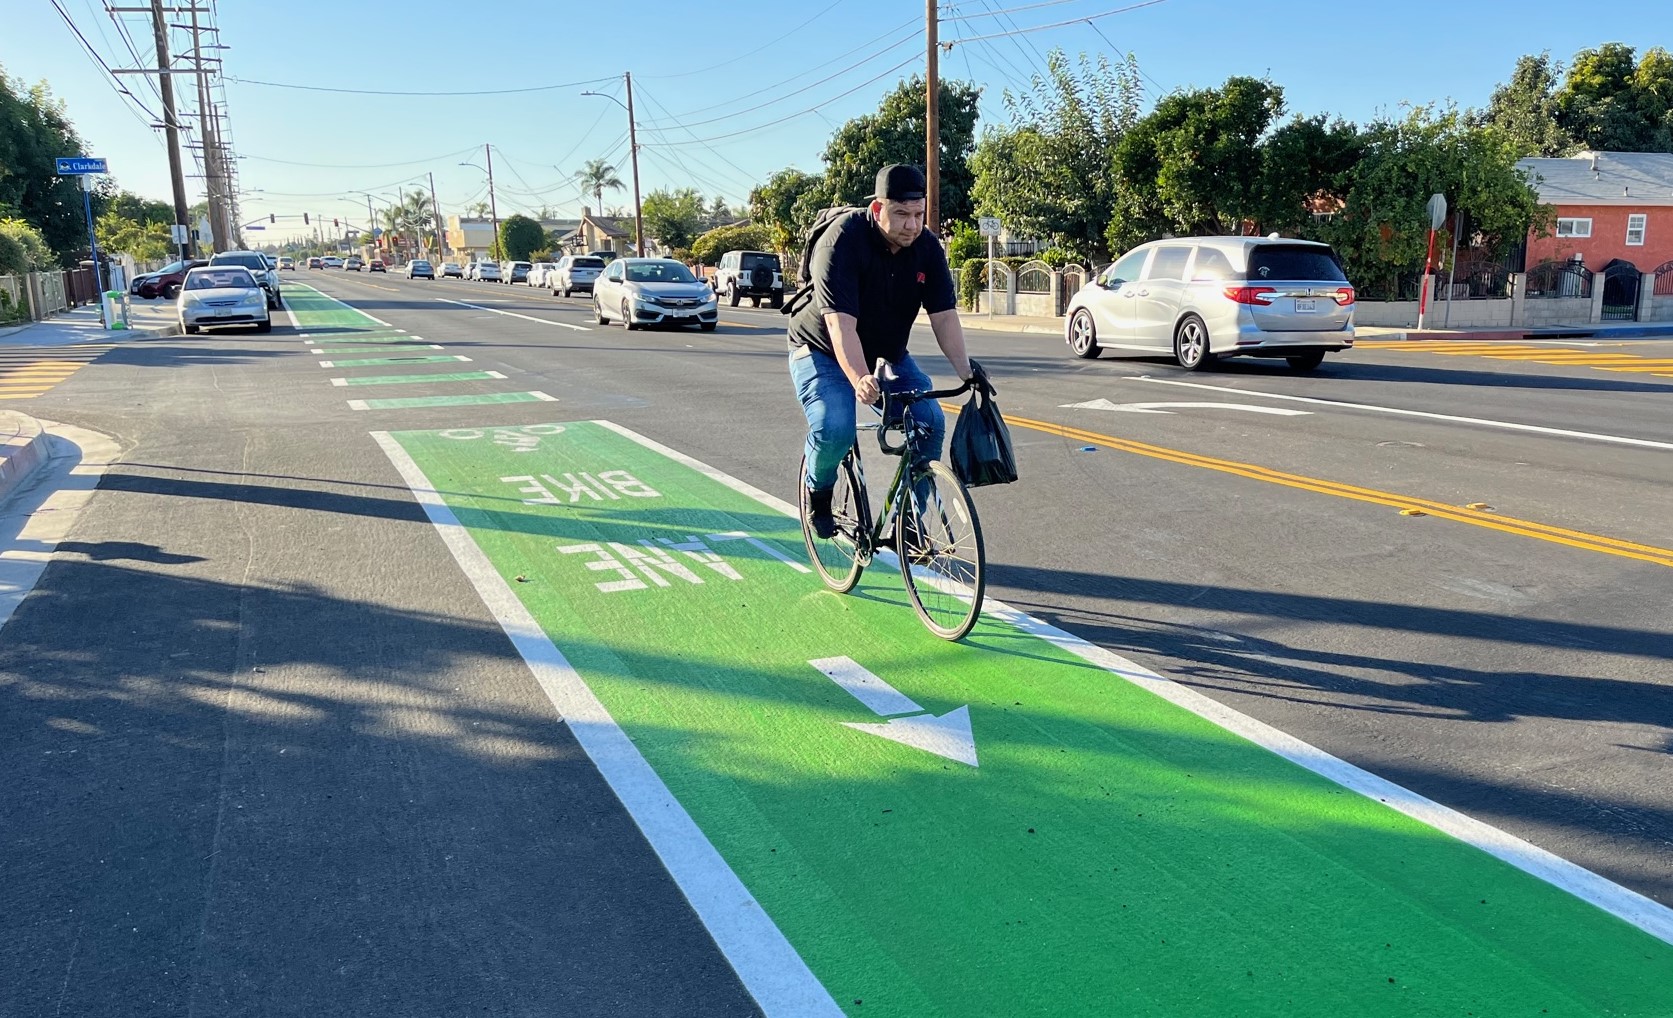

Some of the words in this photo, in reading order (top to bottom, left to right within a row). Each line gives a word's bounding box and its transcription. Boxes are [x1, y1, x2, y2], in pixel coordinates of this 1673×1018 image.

[72, 162, 106, 171] Clarkdale
[501, 469, 662, 506] BIKE
[556, 531, 813, 593] LANE
